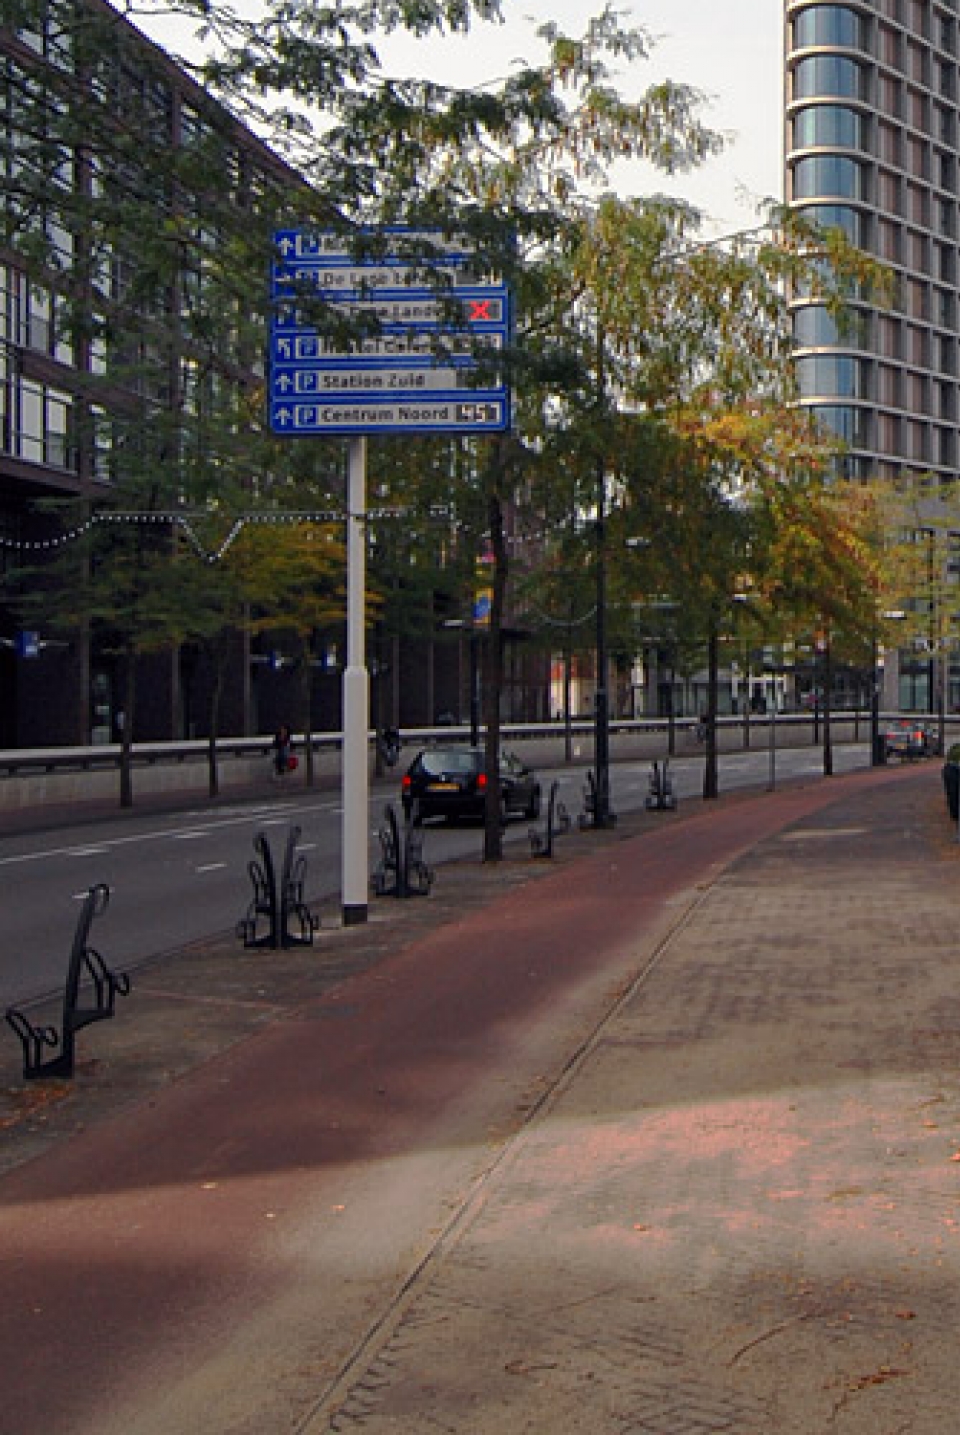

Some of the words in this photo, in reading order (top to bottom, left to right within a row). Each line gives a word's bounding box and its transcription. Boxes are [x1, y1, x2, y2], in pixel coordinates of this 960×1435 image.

[323, 373, 383, 388] Station
[388, 372, 425, 387] Zuid
[321, 407, 394, 422] Centrum
[398, 406, 449, 420] Noord
